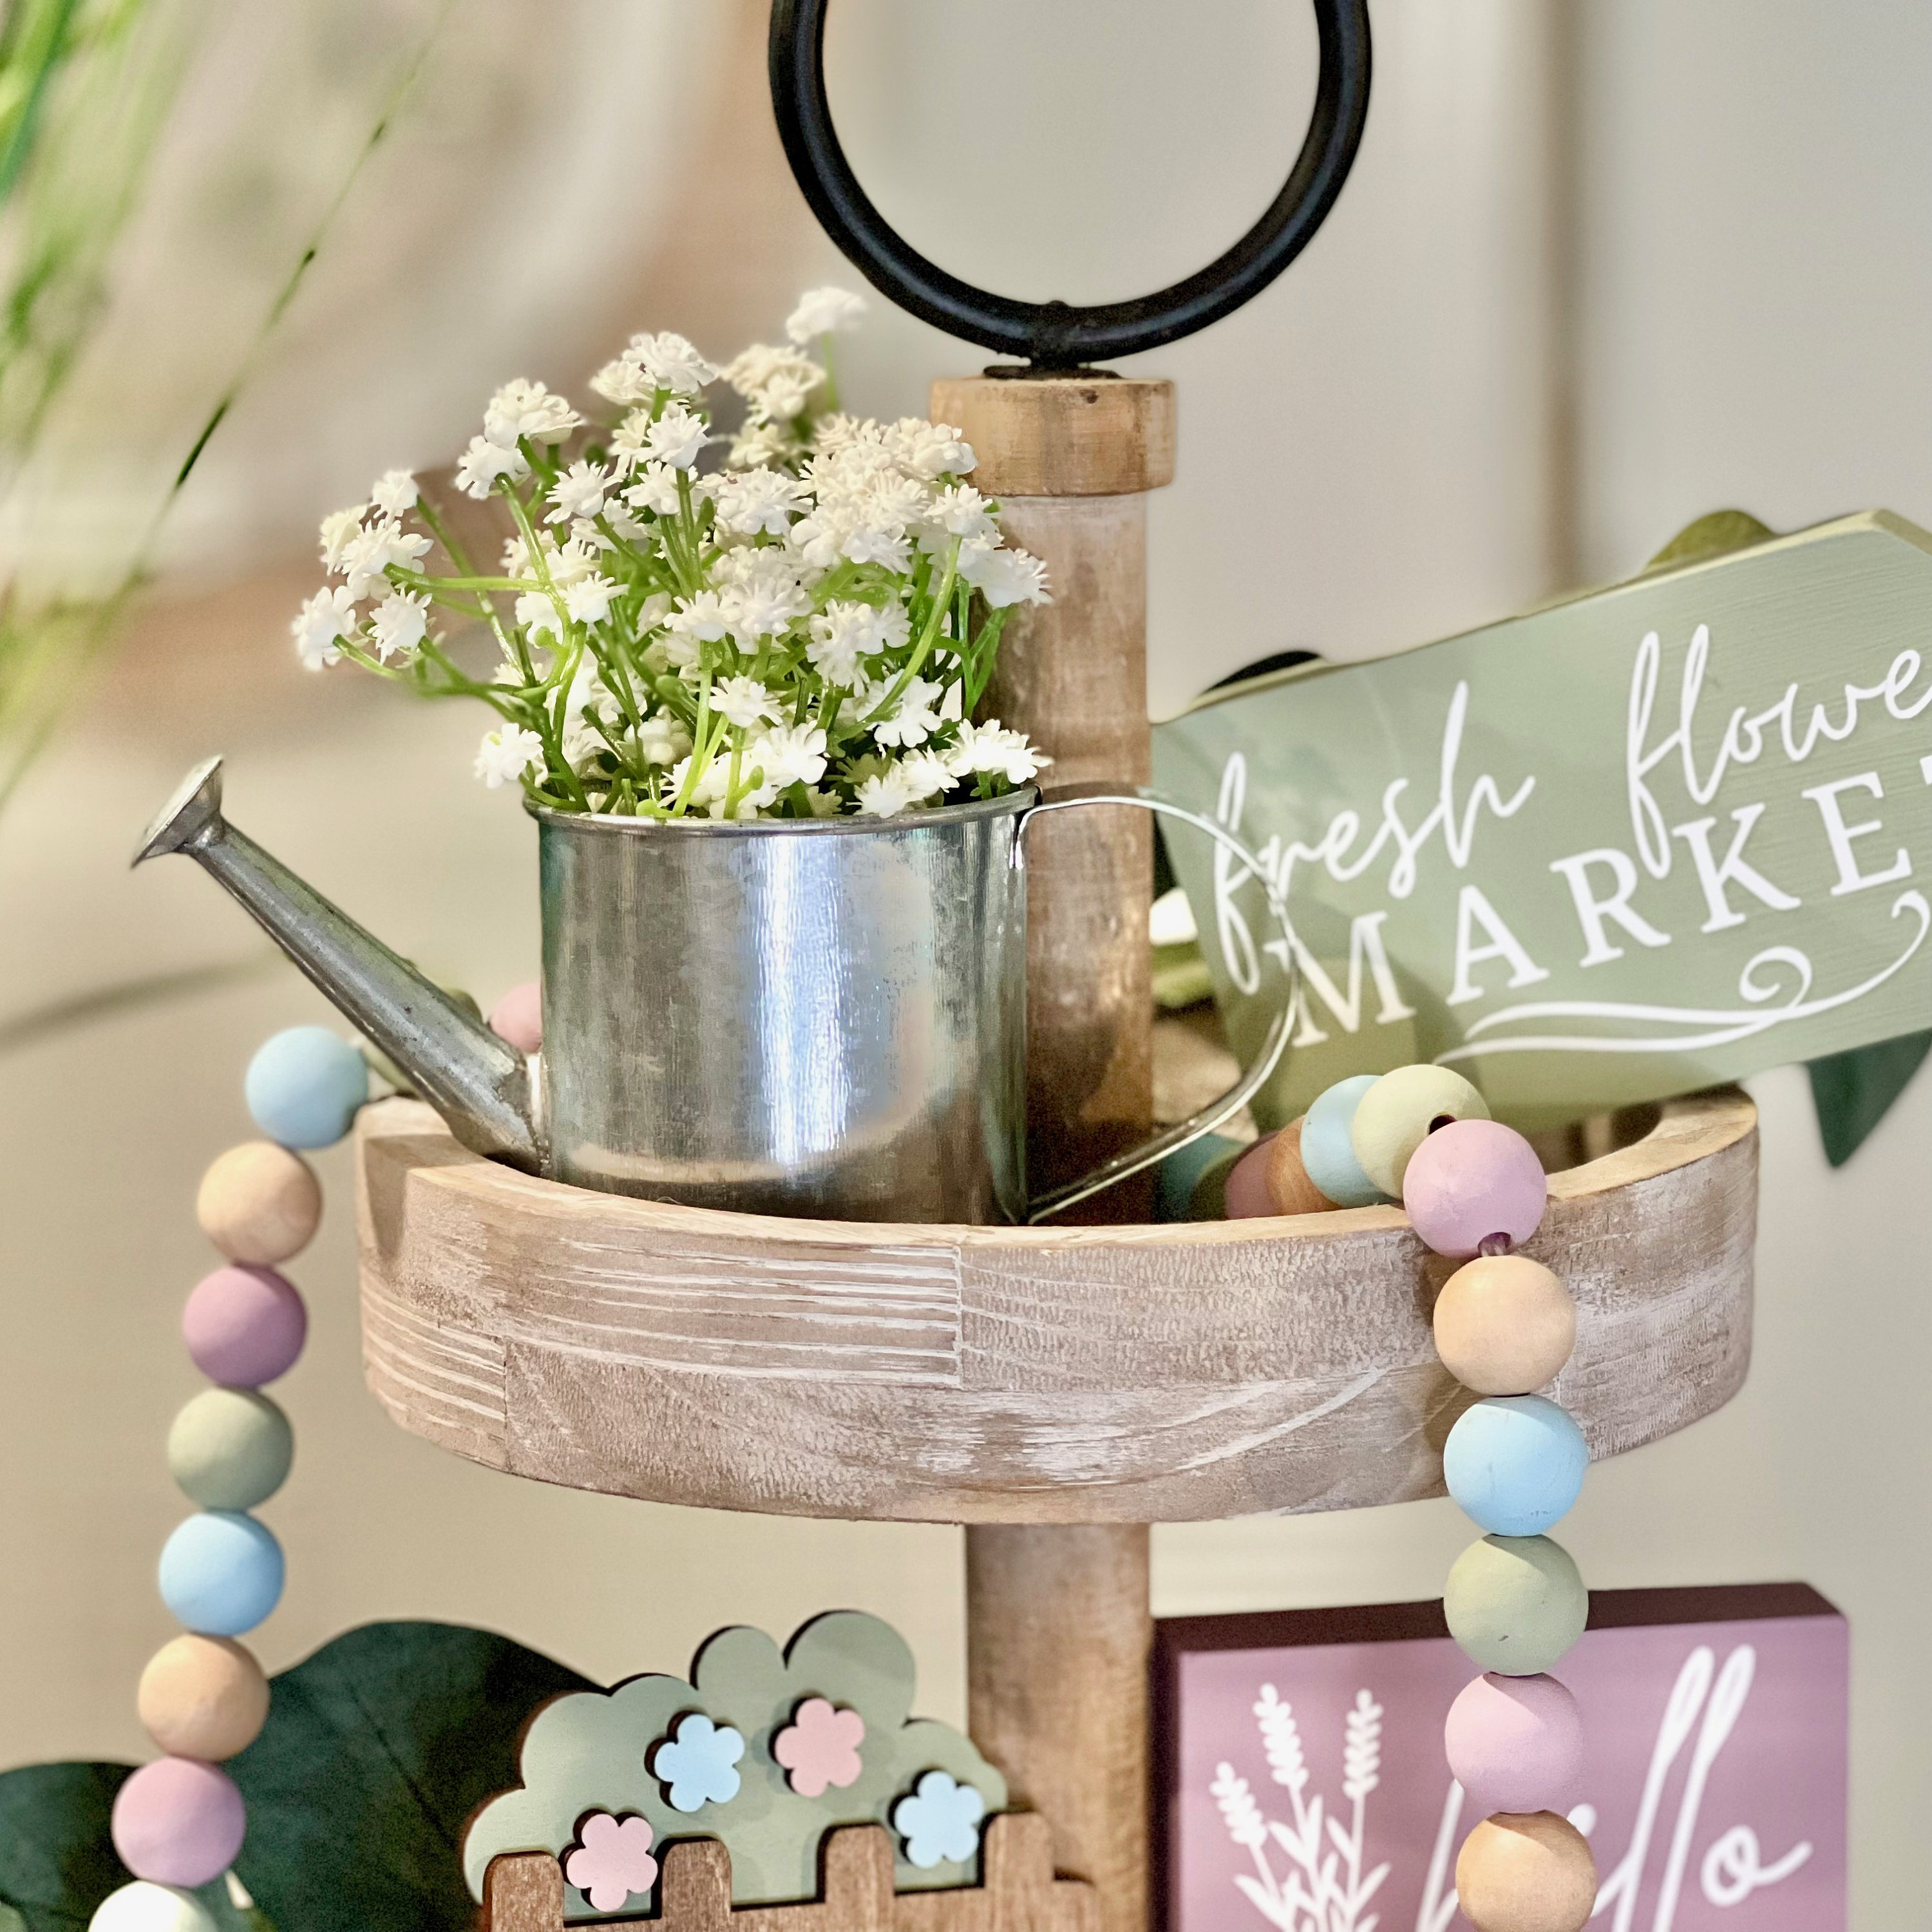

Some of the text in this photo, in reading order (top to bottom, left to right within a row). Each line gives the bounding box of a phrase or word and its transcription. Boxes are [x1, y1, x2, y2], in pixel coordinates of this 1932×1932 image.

[1214, 681, 1536, 996] fresh
[1263, 754, 1932, 1048] MARKE
[1415, 1645, 1813, 1932] llo
